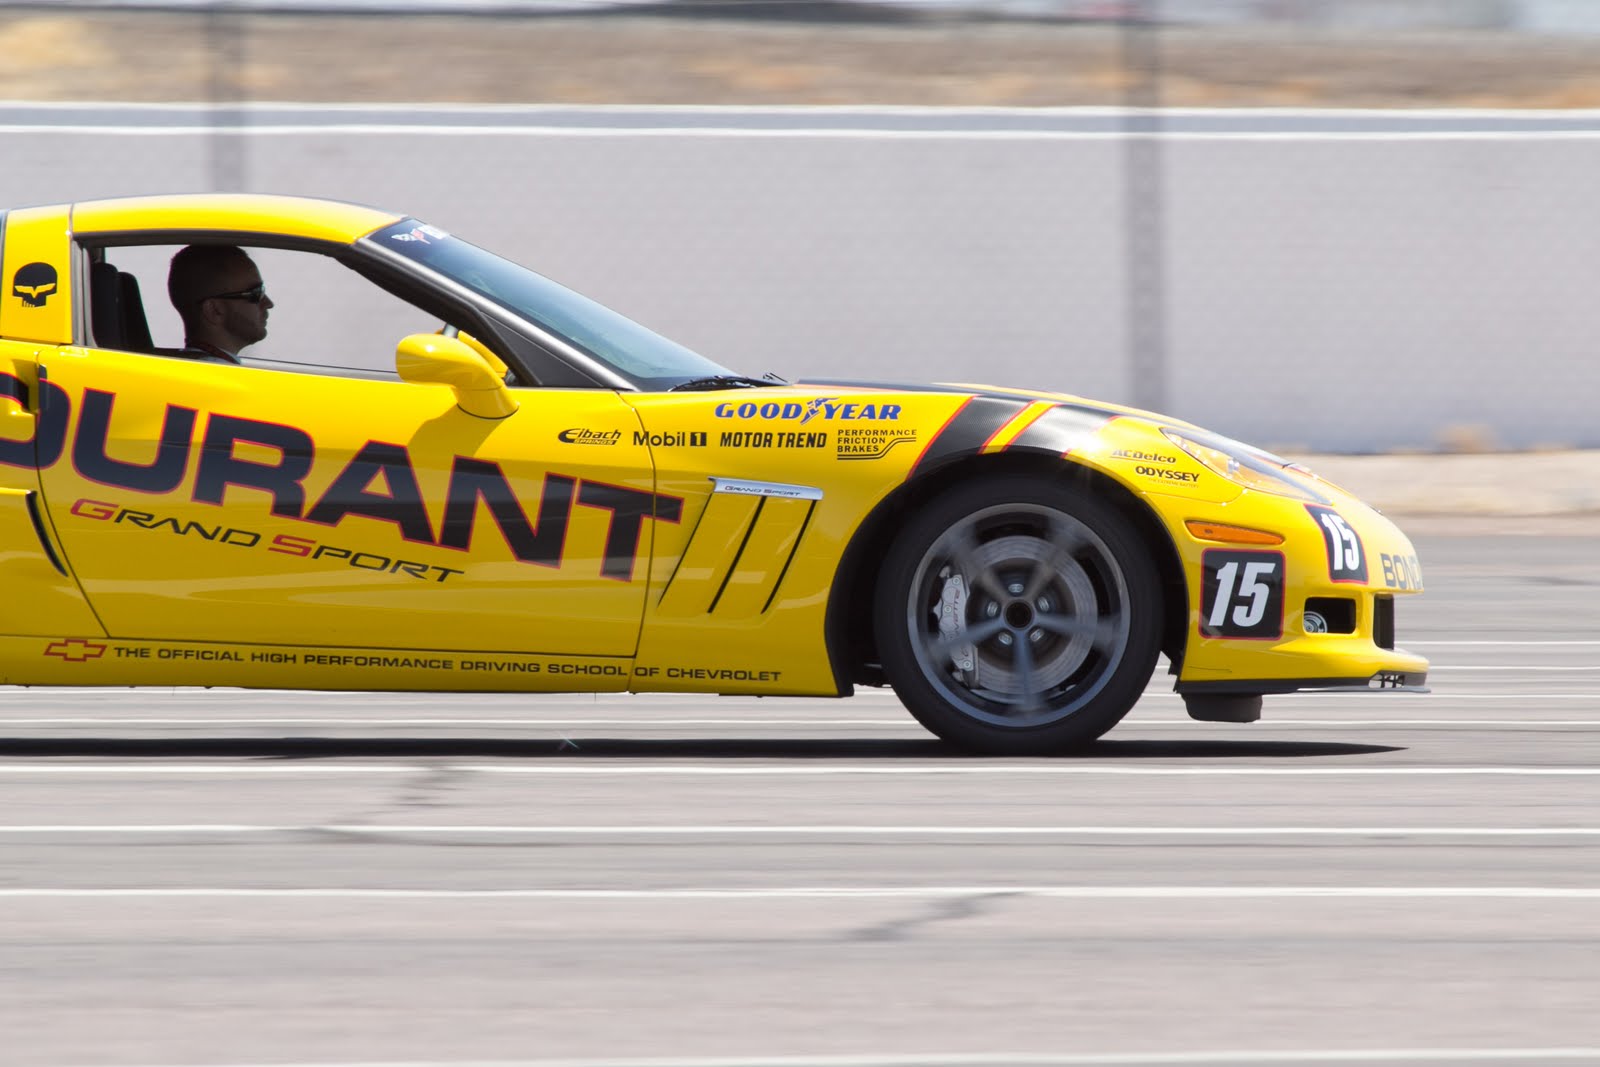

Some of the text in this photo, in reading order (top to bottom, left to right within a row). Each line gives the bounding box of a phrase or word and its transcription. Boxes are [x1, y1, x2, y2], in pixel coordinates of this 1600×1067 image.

[714, 401, 902, 421] GOODYEAR
[558, 428, 622, 444] Eibach
[633, 431, 705, 446] Mobil 1
[720, 432, 828, 448] MOTOR TREND
[837, 429, 917, 437] PERFORMANCE
[837, 437, 886, 445] FRICTION
[837, 445, 880, 453] BRAKES
[1111, 449, 1177, 464] ACDelco
[1135, 465, 1200, 483] ODYSSEY
[725, 485, 801, 496] GRAND SPORT
[70, 498, 465, 583] GRAND SPORT
[1320, 512, 1360, 572] 15
[1208, 561, 1276, 628] 15
[114, 647, 782, 682] THE OFFICIAL HIGH PERFORMANCE DRIVING SCHOOL OF CHEVROLET
